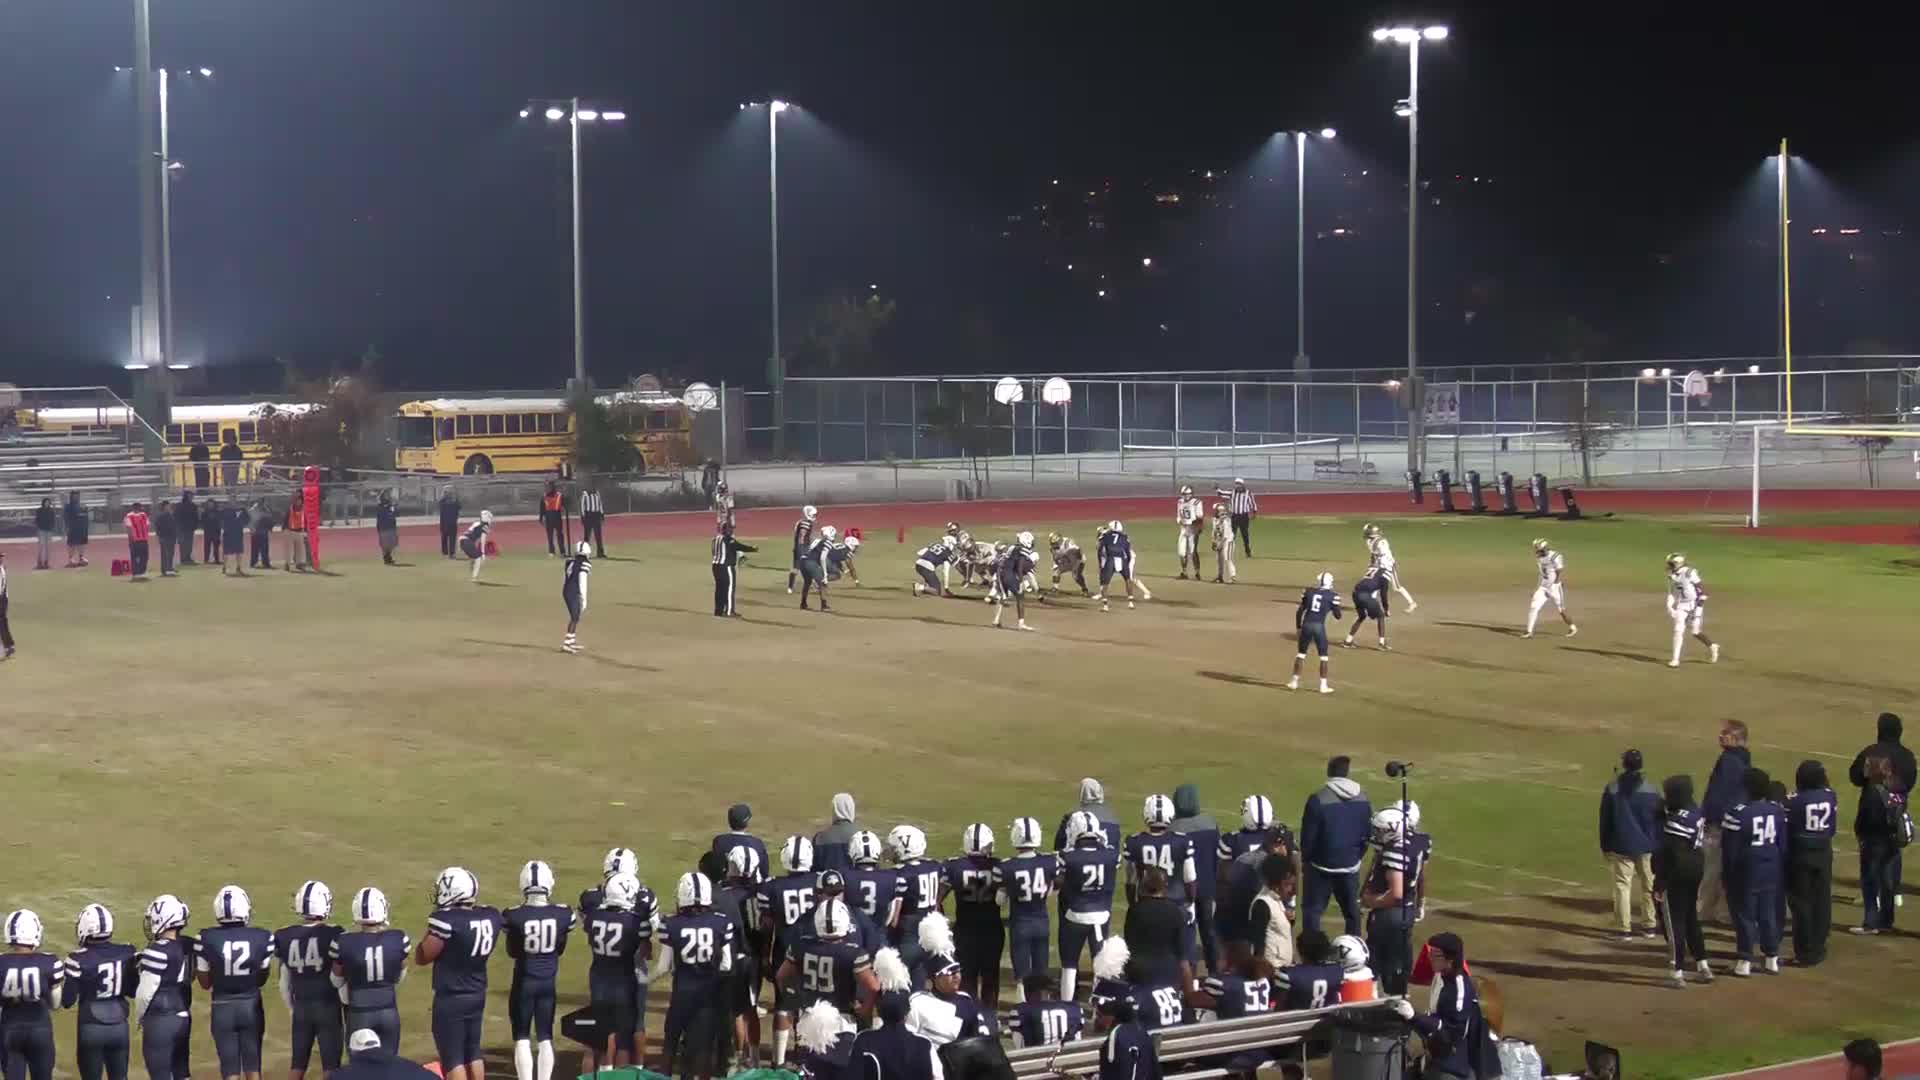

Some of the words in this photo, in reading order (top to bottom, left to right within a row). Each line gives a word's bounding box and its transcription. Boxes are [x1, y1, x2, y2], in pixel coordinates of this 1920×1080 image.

[1111, 533, 1120, 545] 7
[1312, 594, 1322, 612] 6
[1751, 815, 1776, 846] 54
[1805, 803, 1830, 831] 62
[898, 834, 911, 849] V
[918, 872, 938, 909] 90
[1015, 868, 1047, 901] 34
[1082, 864, 1104, 891] 21
[151, 902, 164, 914] V
[860, 881, 877, 915] 3
[470, 920, 493, 956] 78
[524, 919, 557, 954] 80
[592, 920, 623, 957] 32
[681, 927, 713, 964] 28
[222, 941, 250, 976] 12
[288, 938, 322, 973] 44
[364, 946, 384, 982] 11
[803, 953, 834, 992] 59
[2, 967, 40, 1000] 40
[97, 960, 122, 998] 31
[1244, 978, 1270, 1011] 53
[1152, 987, 1183, 1025] 85
[1042, 1009, 1068, 1046] 10
